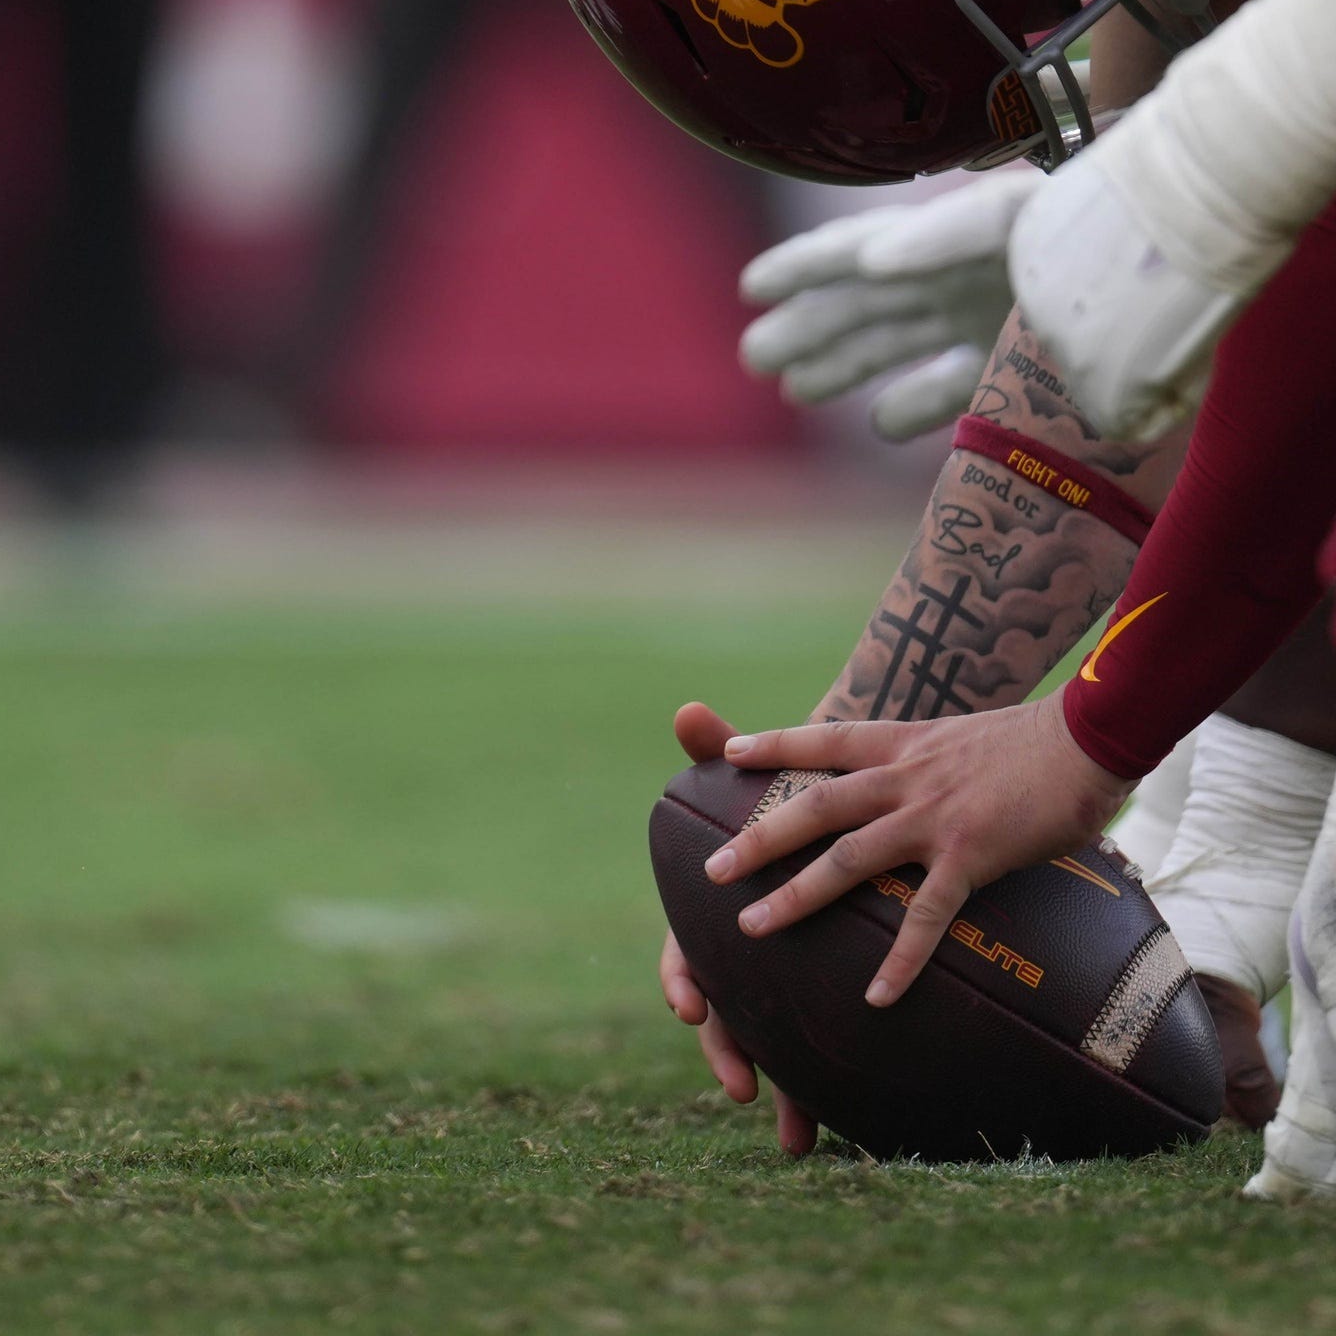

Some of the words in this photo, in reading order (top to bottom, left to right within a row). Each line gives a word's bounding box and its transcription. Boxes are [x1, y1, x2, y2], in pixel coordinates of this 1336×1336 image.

[961, 463, 1013, 503] good
[1014, 494, 1040, 519] or
[1007, 449, 1058, 487] FIGHT
[1058, 478, 1091, 508] ON!
[930, 504, 1023, 580] Bad
[949, 919, 1045, 989] ELITE
